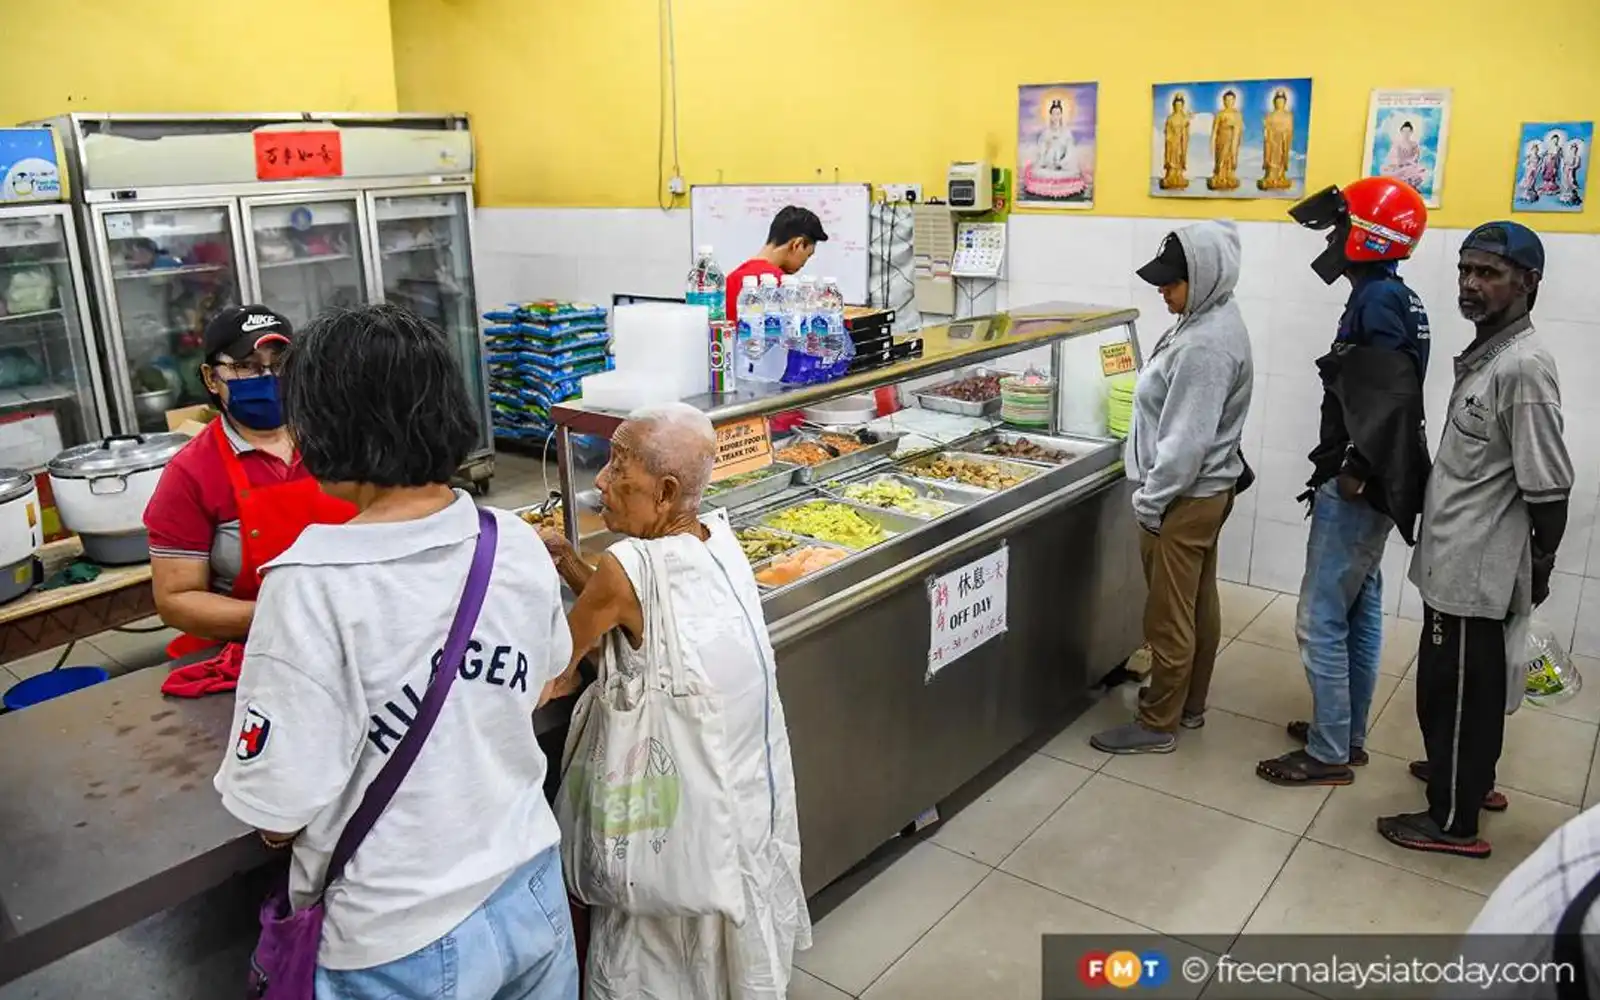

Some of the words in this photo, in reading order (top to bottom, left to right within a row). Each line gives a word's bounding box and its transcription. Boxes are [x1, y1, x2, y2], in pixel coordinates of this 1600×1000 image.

[247, 314, 276, 325] NIKE
[949, 606, 970, 630] OFF
[972, 595, 994, 618] DAY
